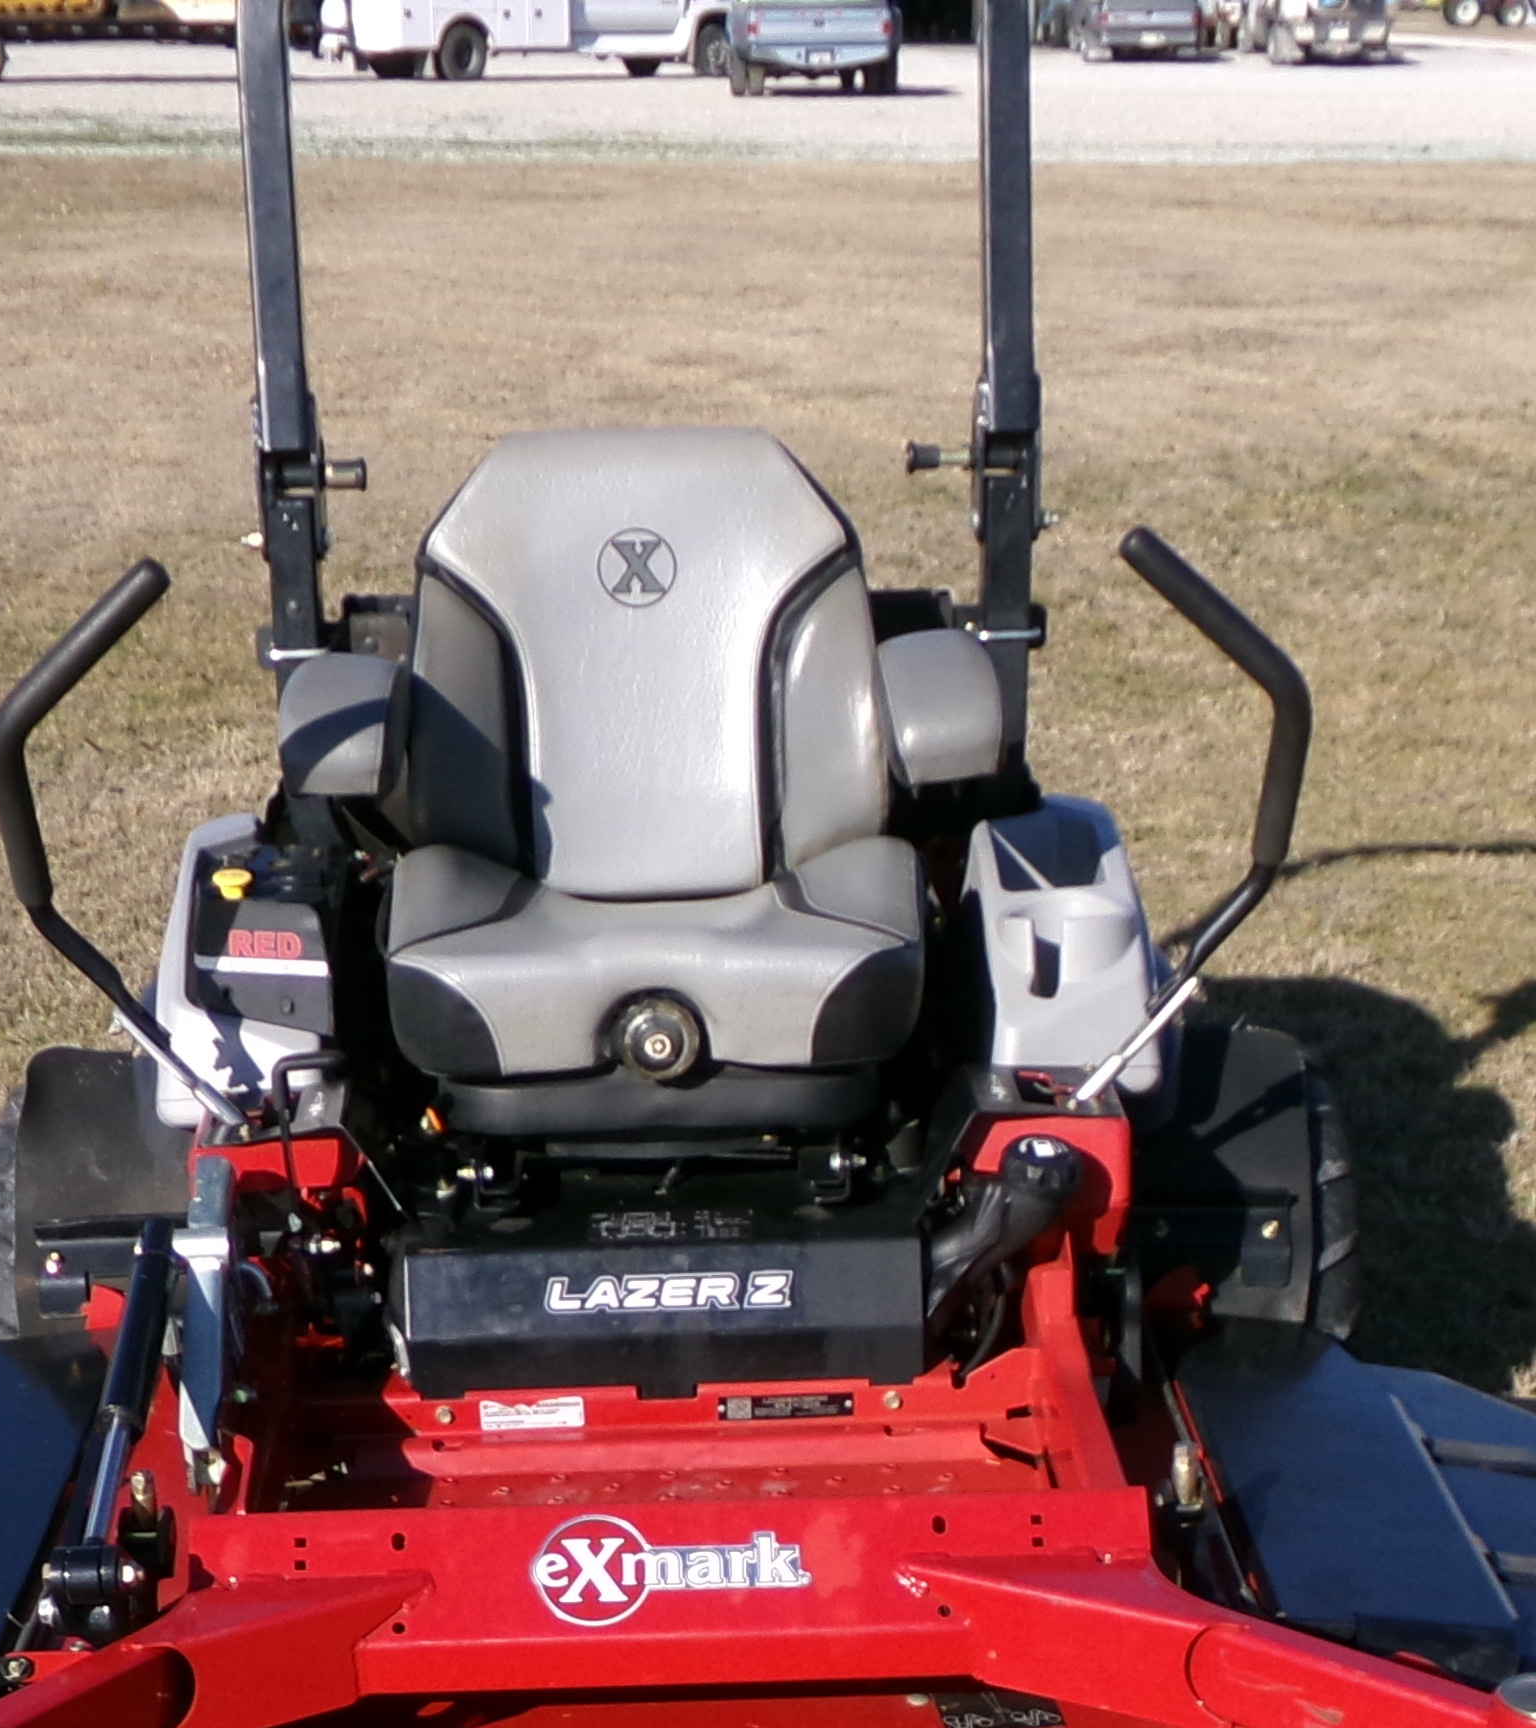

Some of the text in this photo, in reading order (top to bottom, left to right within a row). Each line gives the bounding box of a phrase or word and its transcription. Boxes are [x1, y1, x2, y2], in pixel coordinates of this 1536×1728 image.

[608, 538, 668, 594] X
[228, 929, 302, 959] RED
[546, 1272, 789, 1312] LAZER Z
[533, 1535, 801, 1604] eXmark
